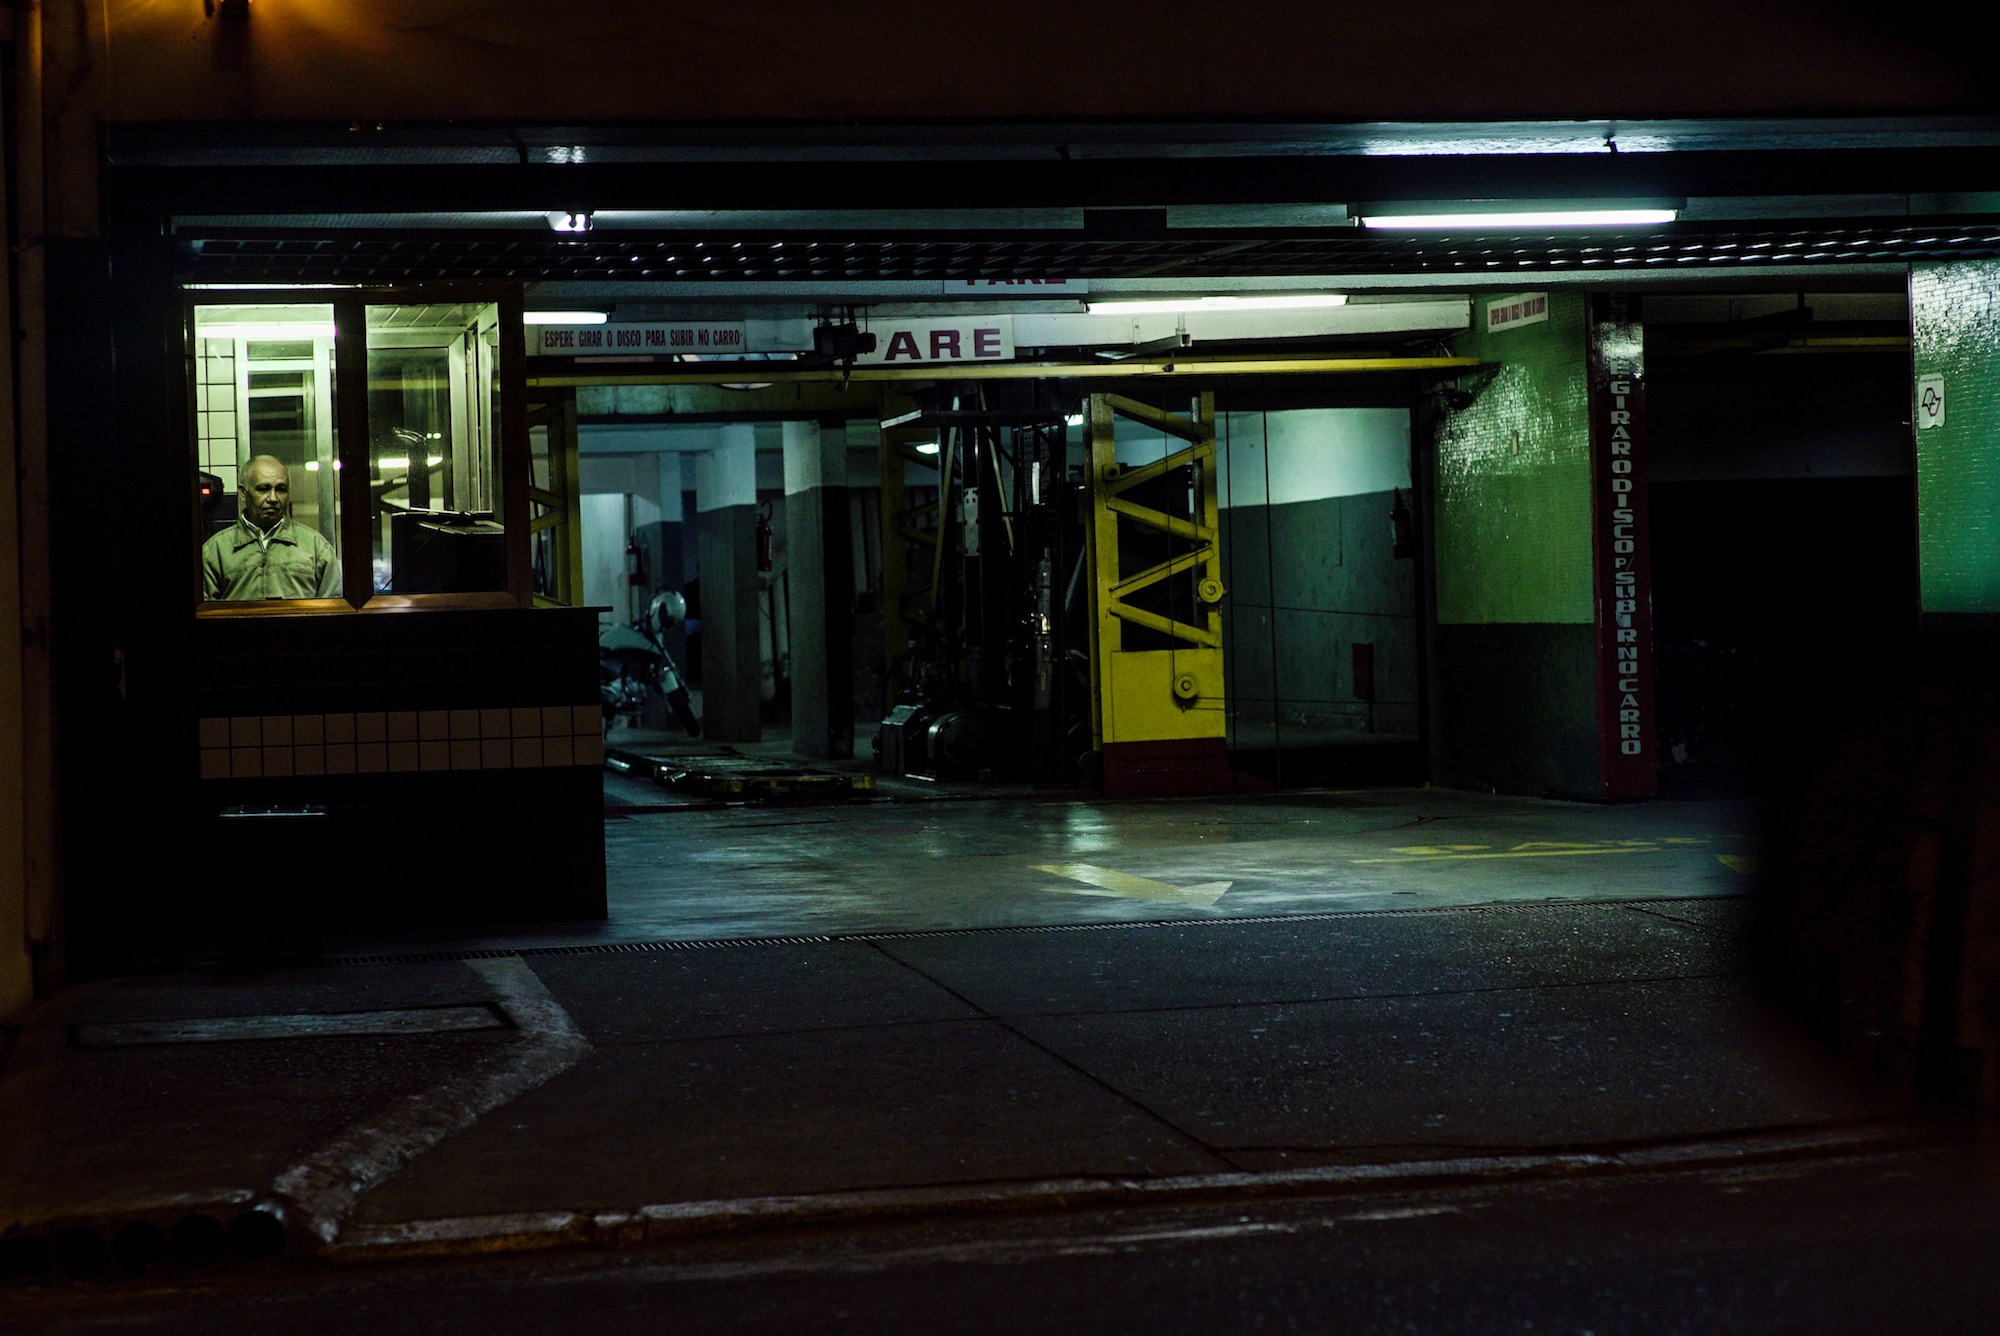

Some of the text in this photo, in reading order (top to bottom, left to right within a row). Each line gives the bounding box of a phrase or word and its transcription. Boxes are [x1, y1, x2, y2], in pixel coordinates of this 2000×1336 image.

[545, 329, 740, 347] ESPERE GIRAR O DISCO PARA SUBIR NO CARRO
[884, 328, 1001, 361] ARE
[1610, 380, 1631, 455] GIRAR
[1611, 459, 1632, 474] O
[1612, 478, 1634, 554] DISCO
[1615, 571, 1638, 643] SUBIR
[1617, 646, 1639, 675] NO
[1618, 678, 1642, 755] CARRO
